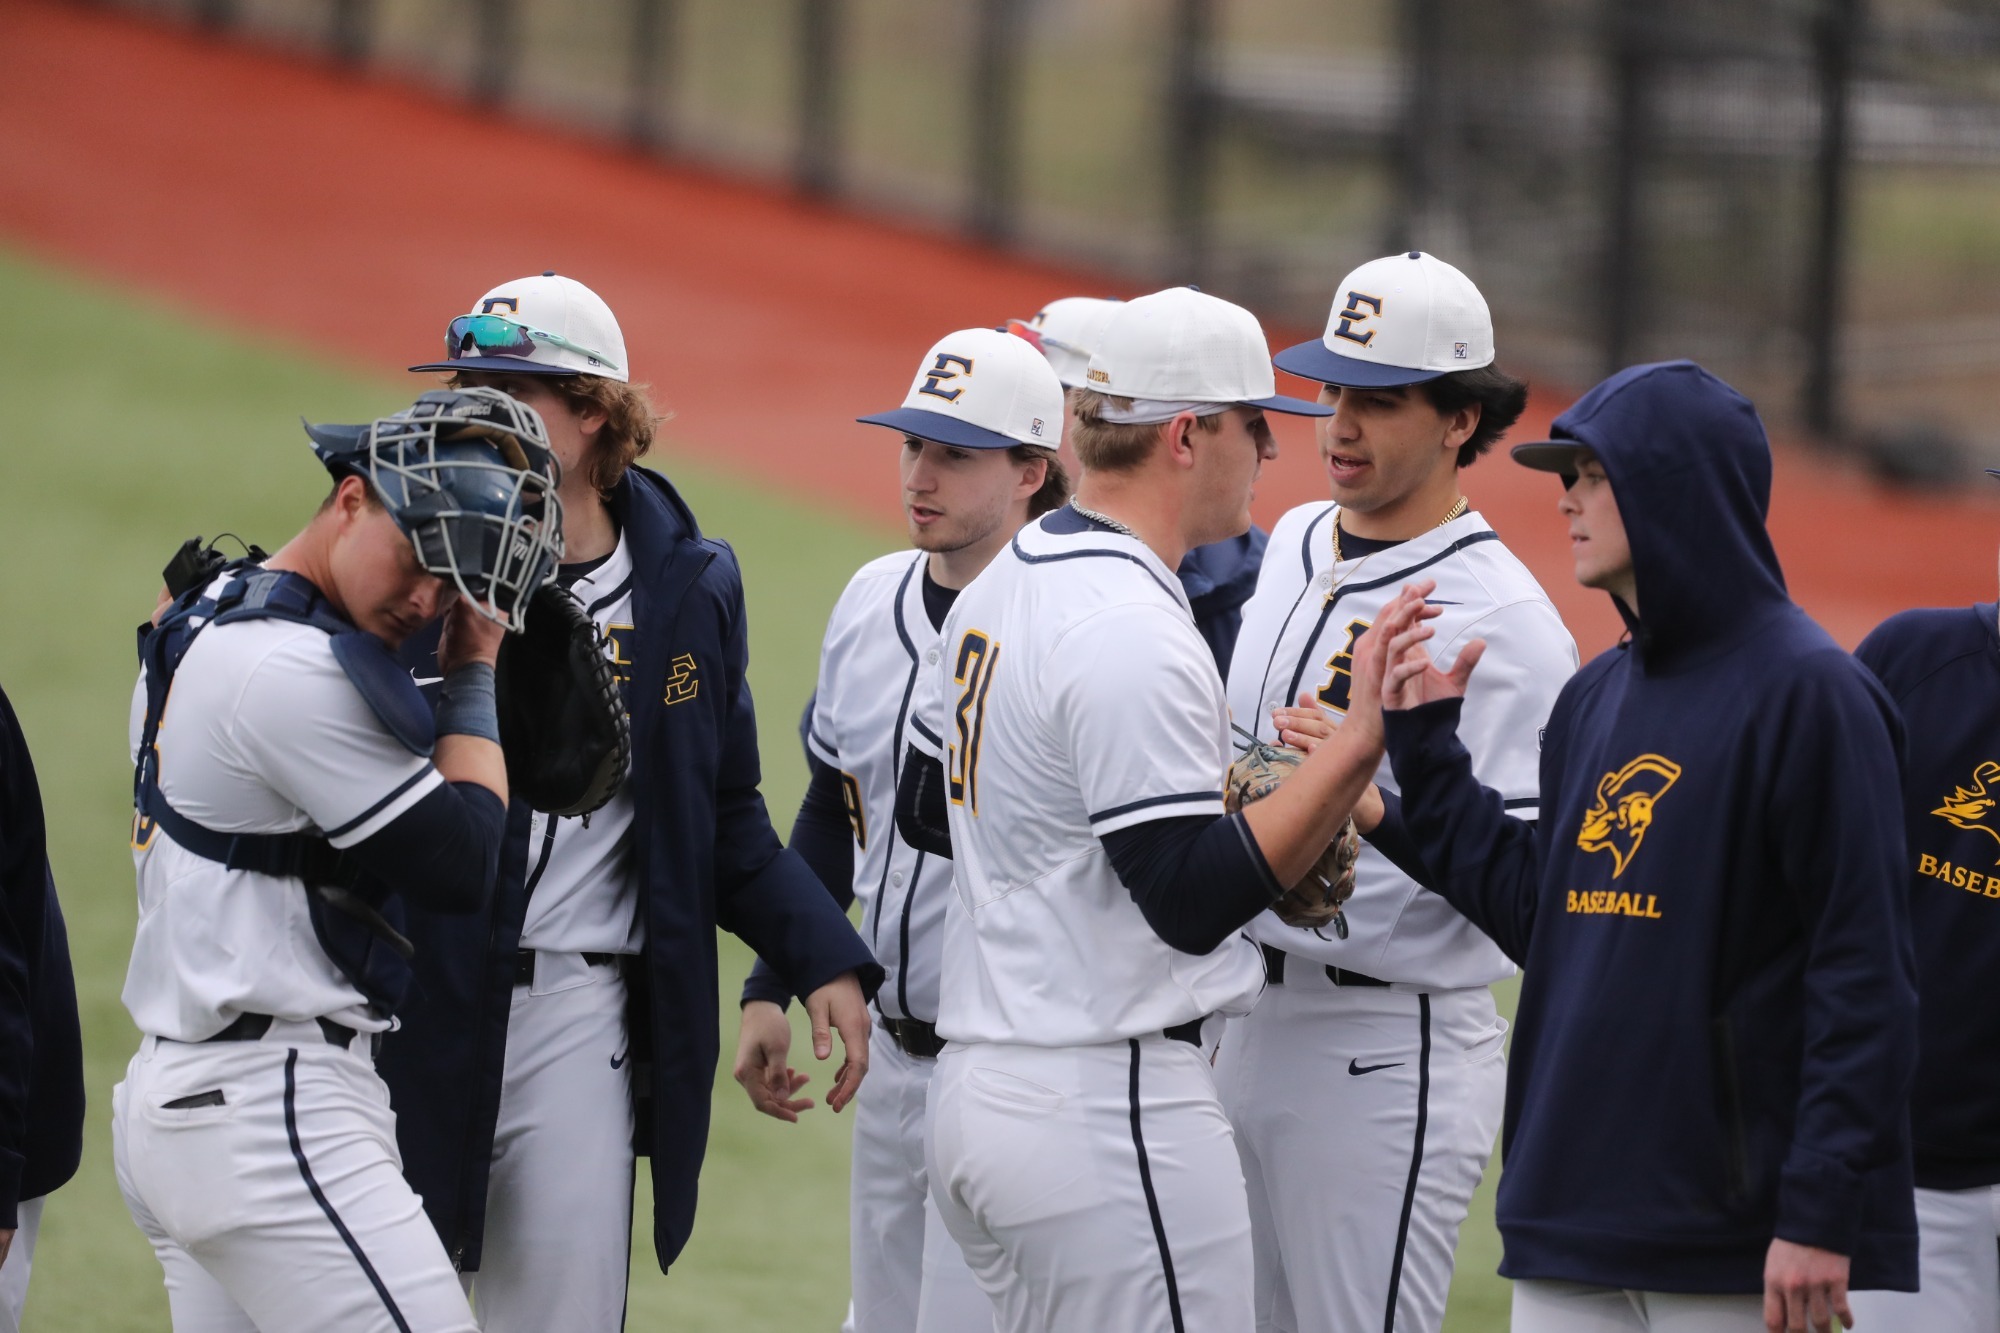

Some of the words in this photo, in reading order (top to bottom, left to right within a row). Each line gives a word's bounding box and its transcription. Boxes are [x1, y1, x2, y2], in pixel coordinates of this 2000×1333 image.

[1333, 289, 1384, 349] E
[918, 352, 976, 405] E
[663, 652, 699, 706] E
[949, 628, 1001, 819] 31
[1566, 889, 1663, 919] BASEBALL
